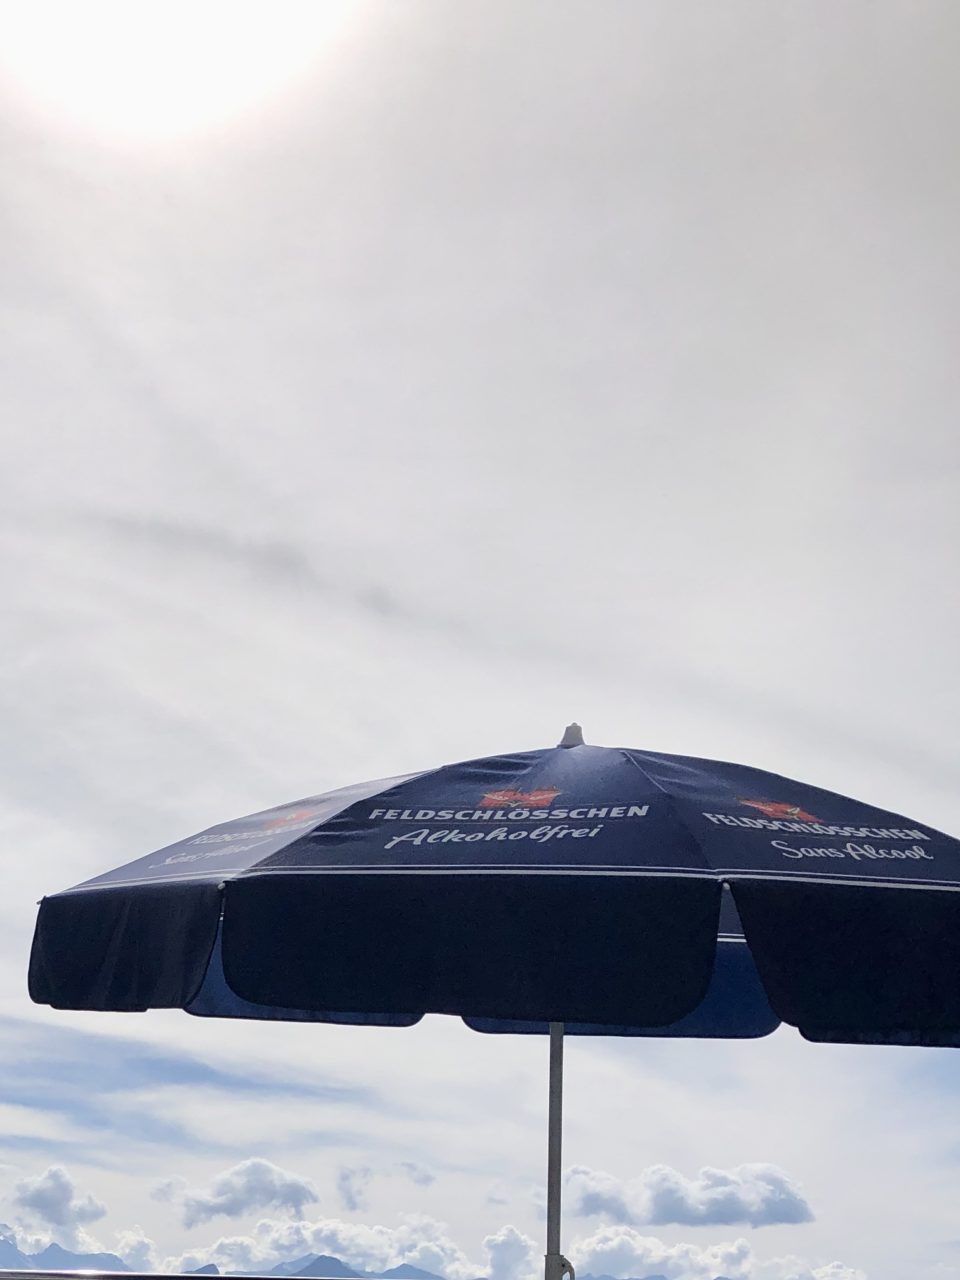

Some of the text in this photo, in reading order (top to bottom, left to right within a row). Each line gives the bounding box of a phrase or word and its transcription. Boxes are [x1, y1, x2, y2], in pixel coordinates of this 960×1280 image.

[368, 805, 649, 821] FELDSCHLÖSSCHEN
[383, 824, 604, 850] Alkoholfrei
[702, 811, 931, 841] FELDSCHLÖSSCHEN
[771, 840, 935, 861] Sans Alcool
